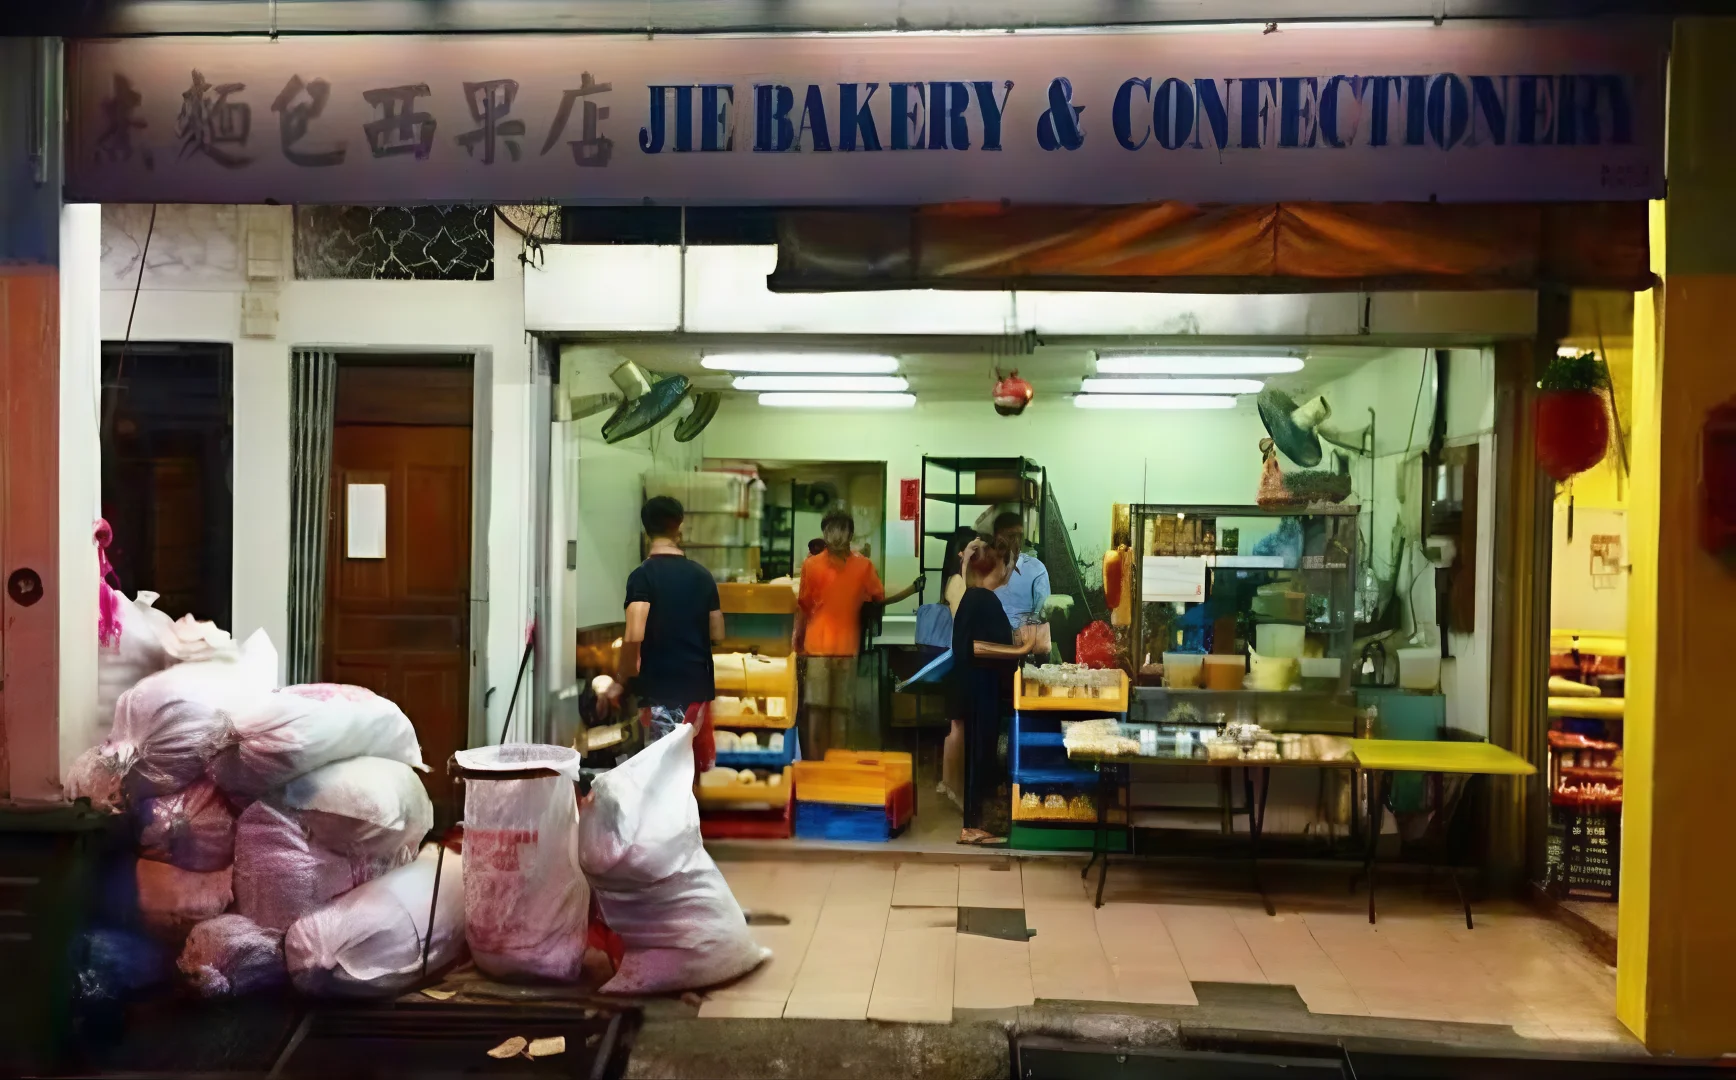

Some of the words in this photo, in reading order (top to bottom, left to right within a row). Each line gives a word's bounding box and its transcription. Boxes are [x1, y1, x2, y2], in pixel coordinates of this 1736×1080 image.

[639, 84, 734, 153] JIE
[753, 80, 1014, 152] BAKERY
[1036, 77, 1086, 152] &
[1112, 72, 1641, 152] CONFECTIONERY
